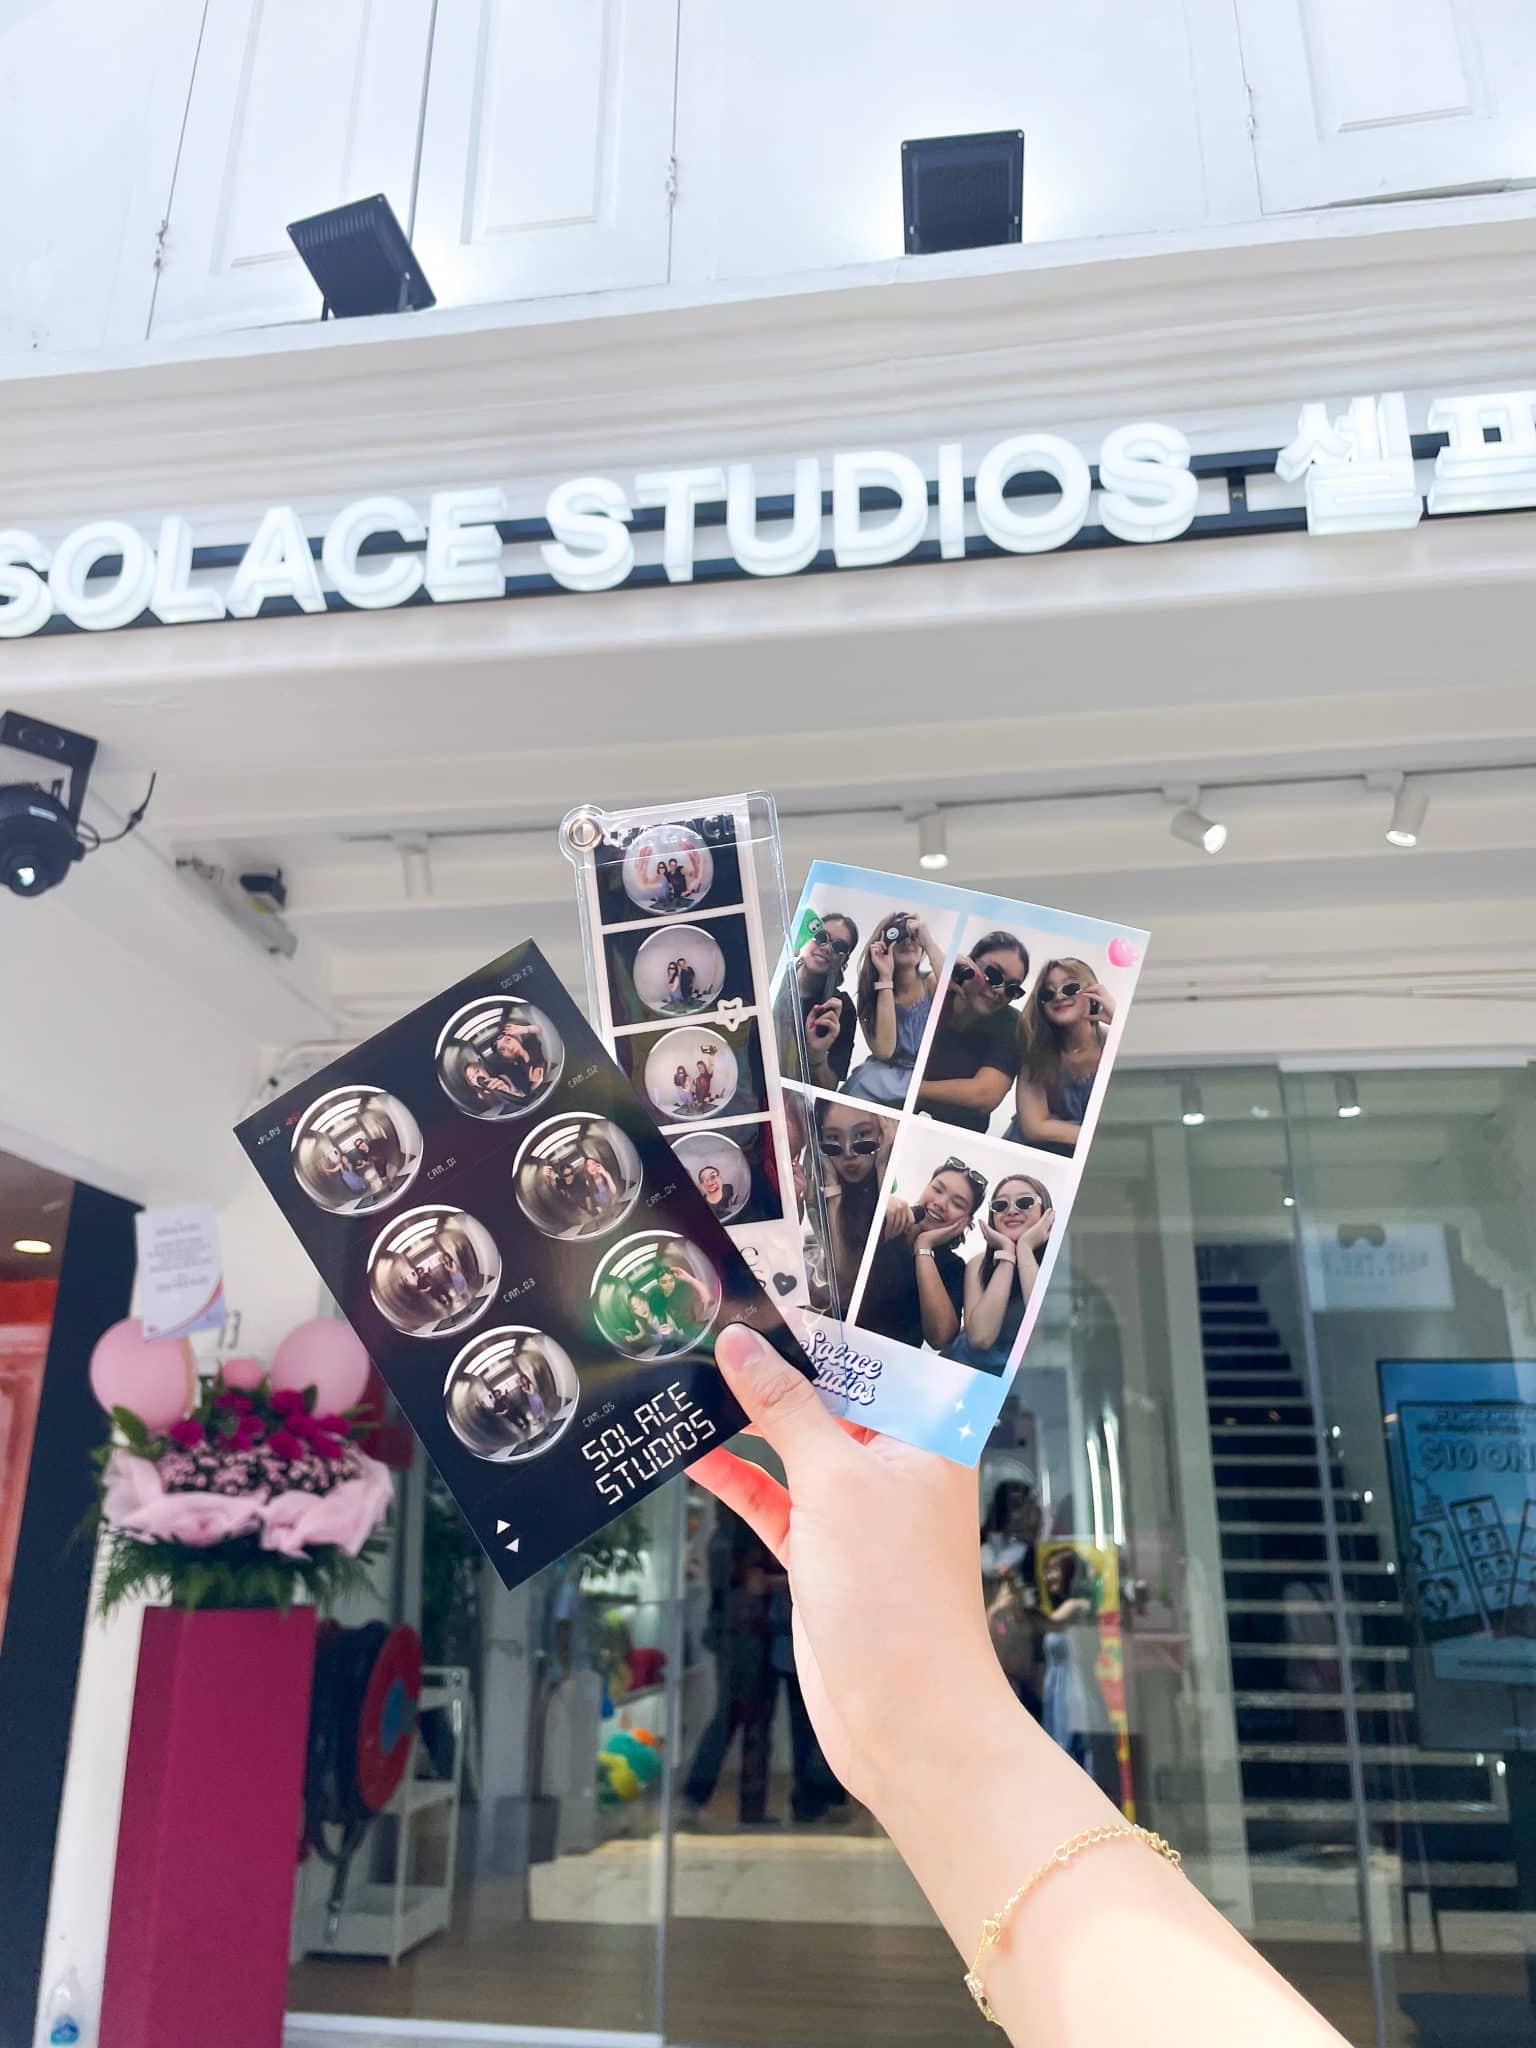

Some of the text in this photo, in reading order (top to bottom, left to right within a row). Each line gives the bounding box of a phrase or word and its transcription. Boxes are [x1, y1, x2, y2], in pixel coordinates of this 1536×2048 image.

[0, 487, 507, 638] SOLACE
[540, 422, 1199, 592] STUDIOS
[800, 1329, 883, 1380] Solace
[581, 1381, 694, 1472] SOLACE
[594, 1408, 717, 1506] STUDIOS
